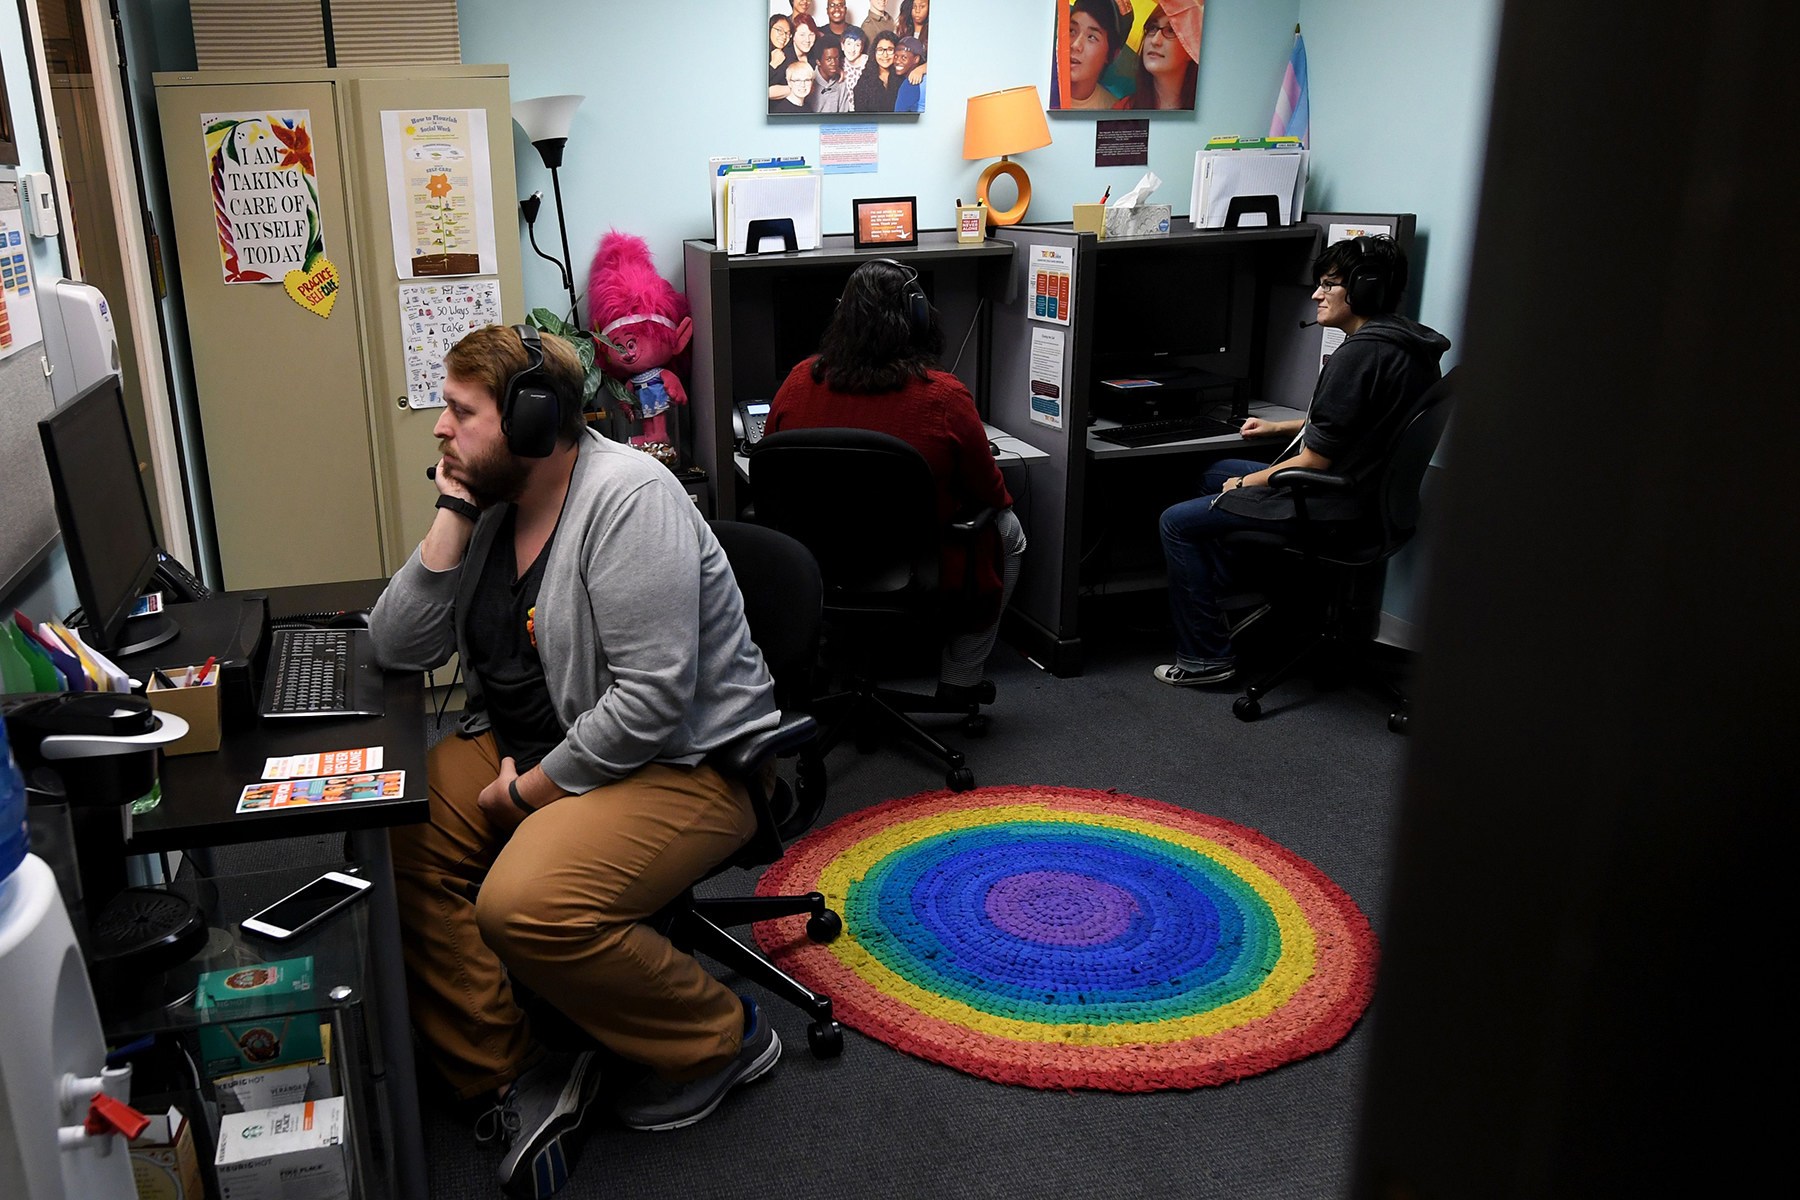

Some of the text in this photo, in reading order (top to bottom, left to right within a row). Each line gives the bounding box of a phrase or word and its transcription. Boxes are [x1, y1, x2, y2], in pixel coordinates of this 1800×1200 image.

[242, 146, 280, 166] I AM
[229, 170, 299, 191] TAKING
[230, 195, 305, 216] CARE OF
[234, 220, 306, 240] MYSELF
[244, 244, 303, 264] TODAY
[297, 266, 333, 297] PRACTICE
[437, 306, 448, 316] 50
[449, 306, 470, 320] Ways
[324, 754, 334, 774] YOU ARE
[335, 752, 348, 774] NEVER
[349, 750, 362, 772] ALONE
[274, 783, 291, 805] TREVOR
[218, 1080, 248, 1089] KEURIG
[271, 1085, 302, 1094] VERANDA
[282, 1113, 290, 1133] PLACE
[220, 1159, 272, 1172] KEURIG HOT
